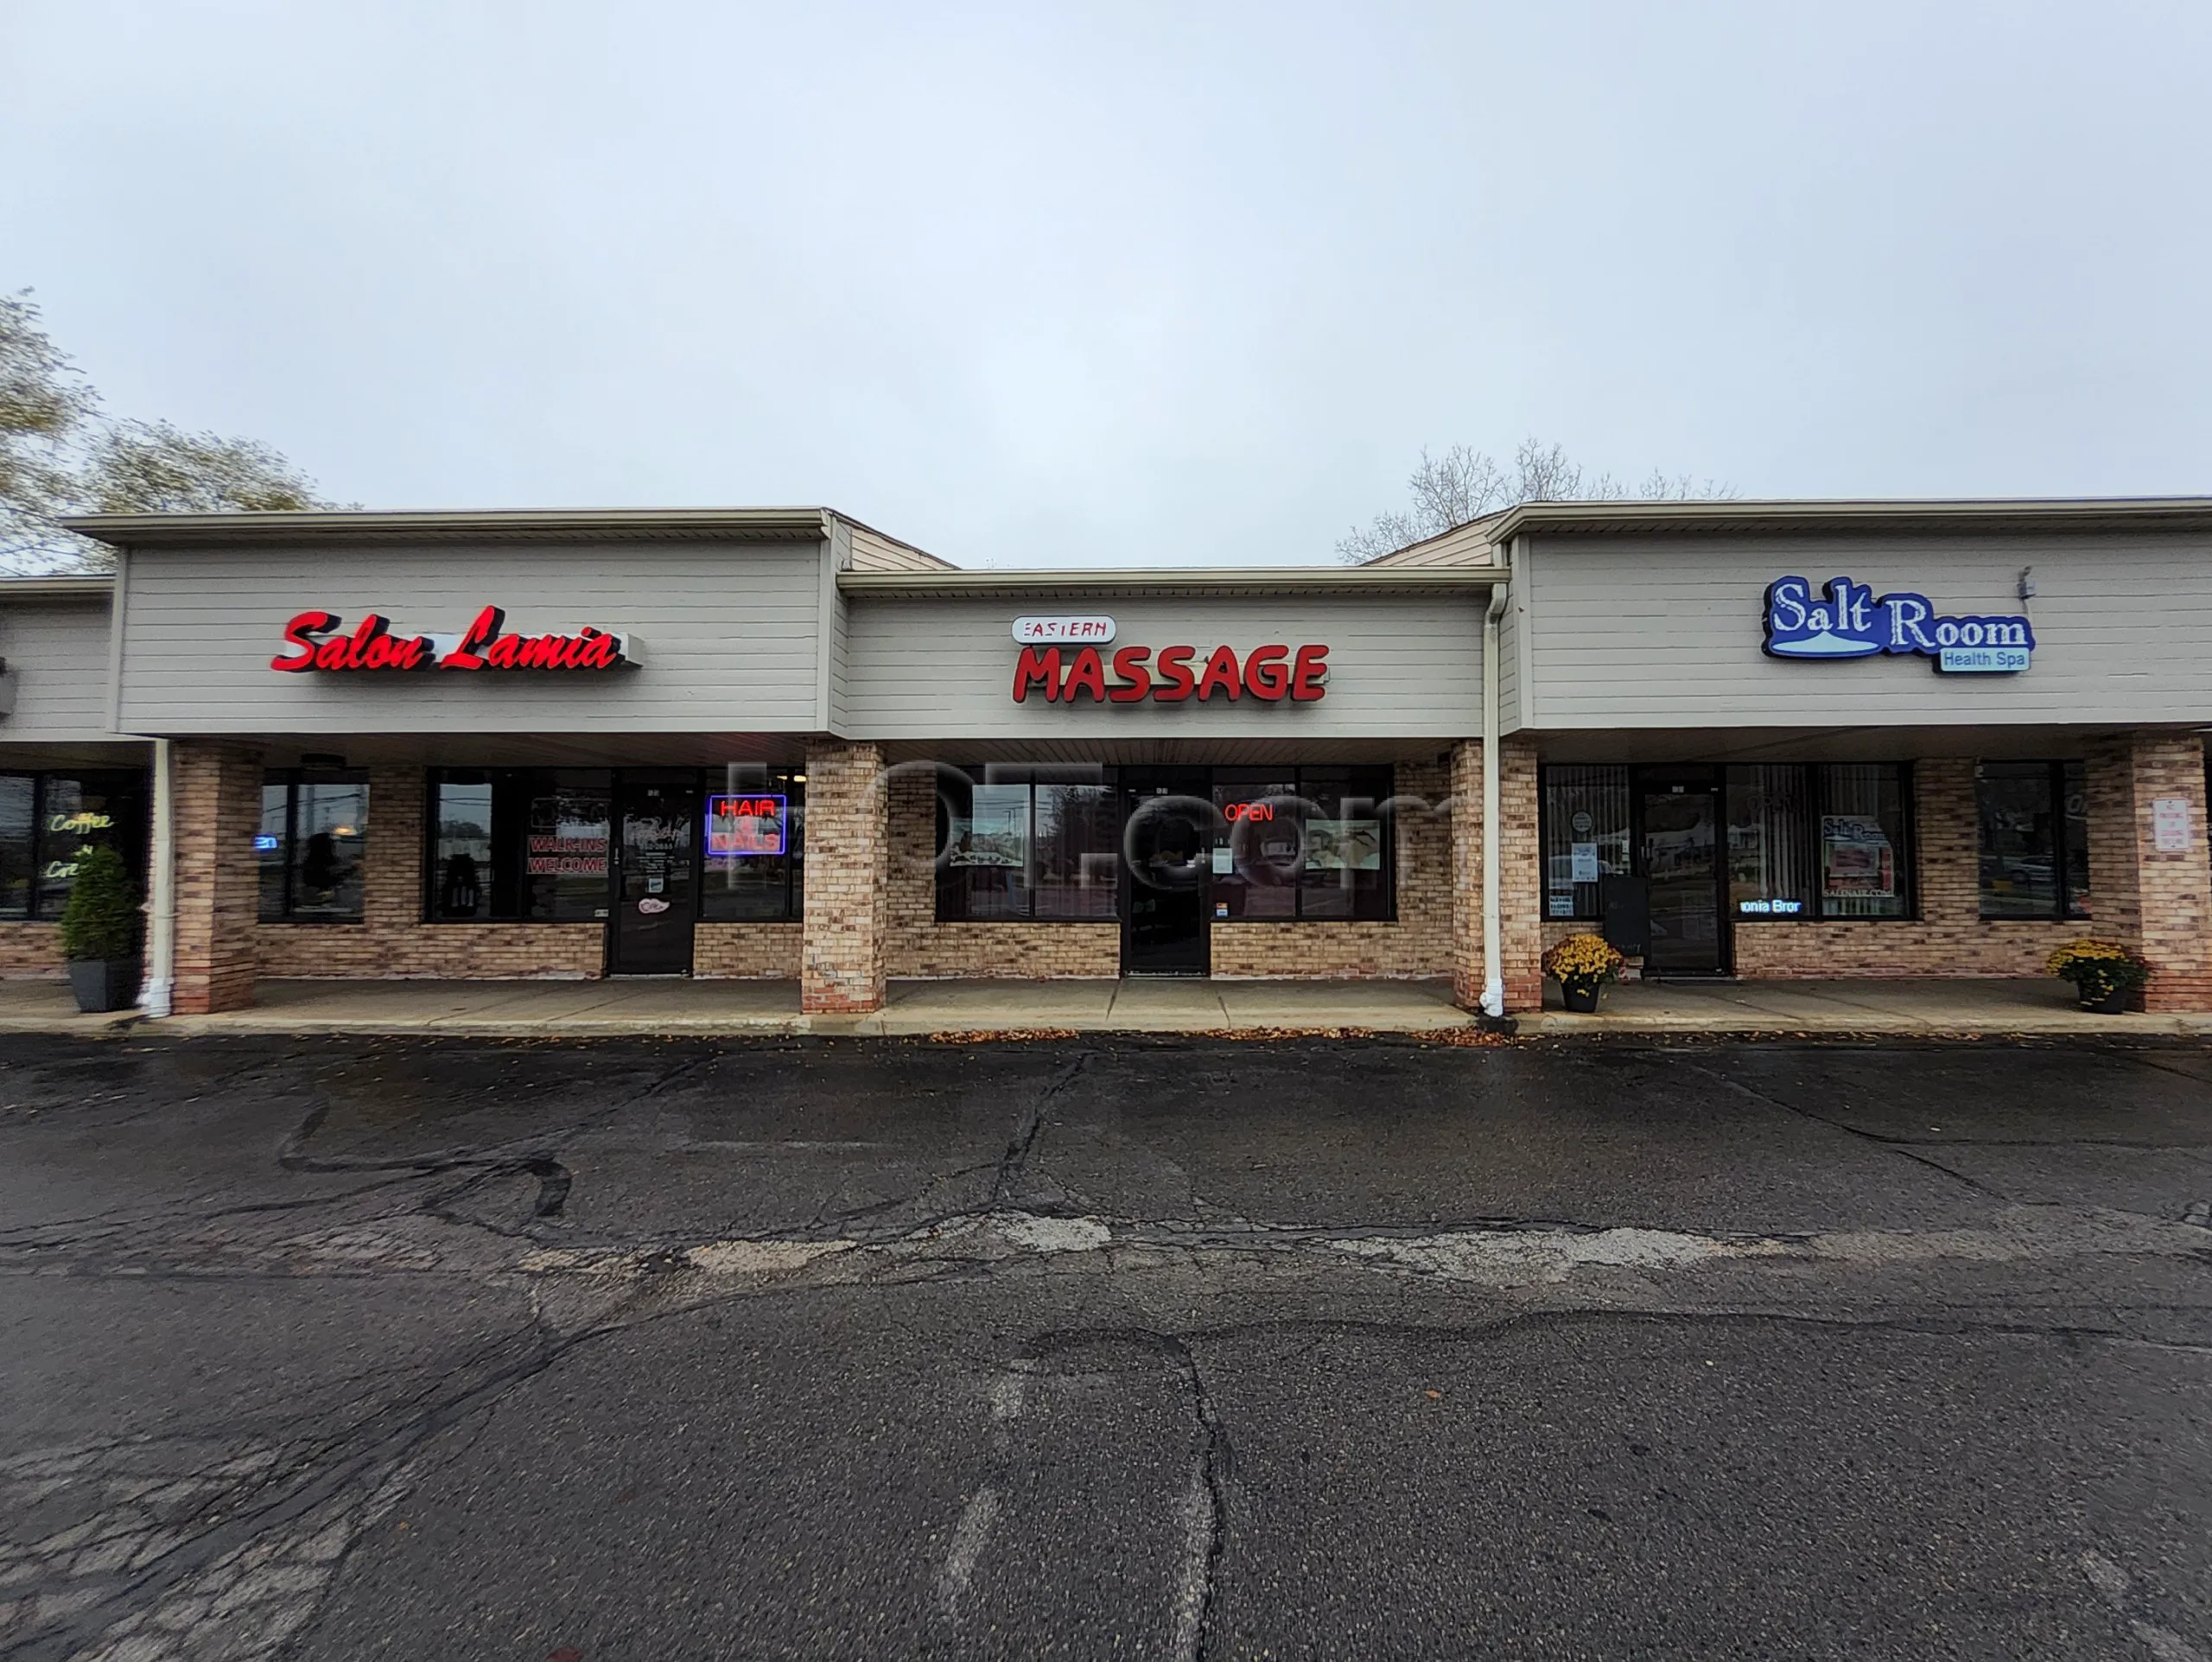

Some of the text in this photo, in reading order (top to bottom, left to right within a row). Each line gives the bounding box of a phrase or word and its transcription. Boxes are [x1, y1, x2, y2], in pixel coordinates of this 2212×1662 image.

[1772, 583, 2030, 647] Salt Room
[270, 604, 620, 672] Salon Lamia
[1943, 651, 2026, 669] Health Spa
[1012, 644, 1331, 704] MASSAGE
[720, 799, 776, 817] HAIR
[1224, 803, 1274, 822] OPEN
[50, 812, 116, 835] Coffee
[530, 836, 607, 852] WALK-INS
[711, 834, 779, 851] NAILS
[530, 856, 607, 872] WELCOME
